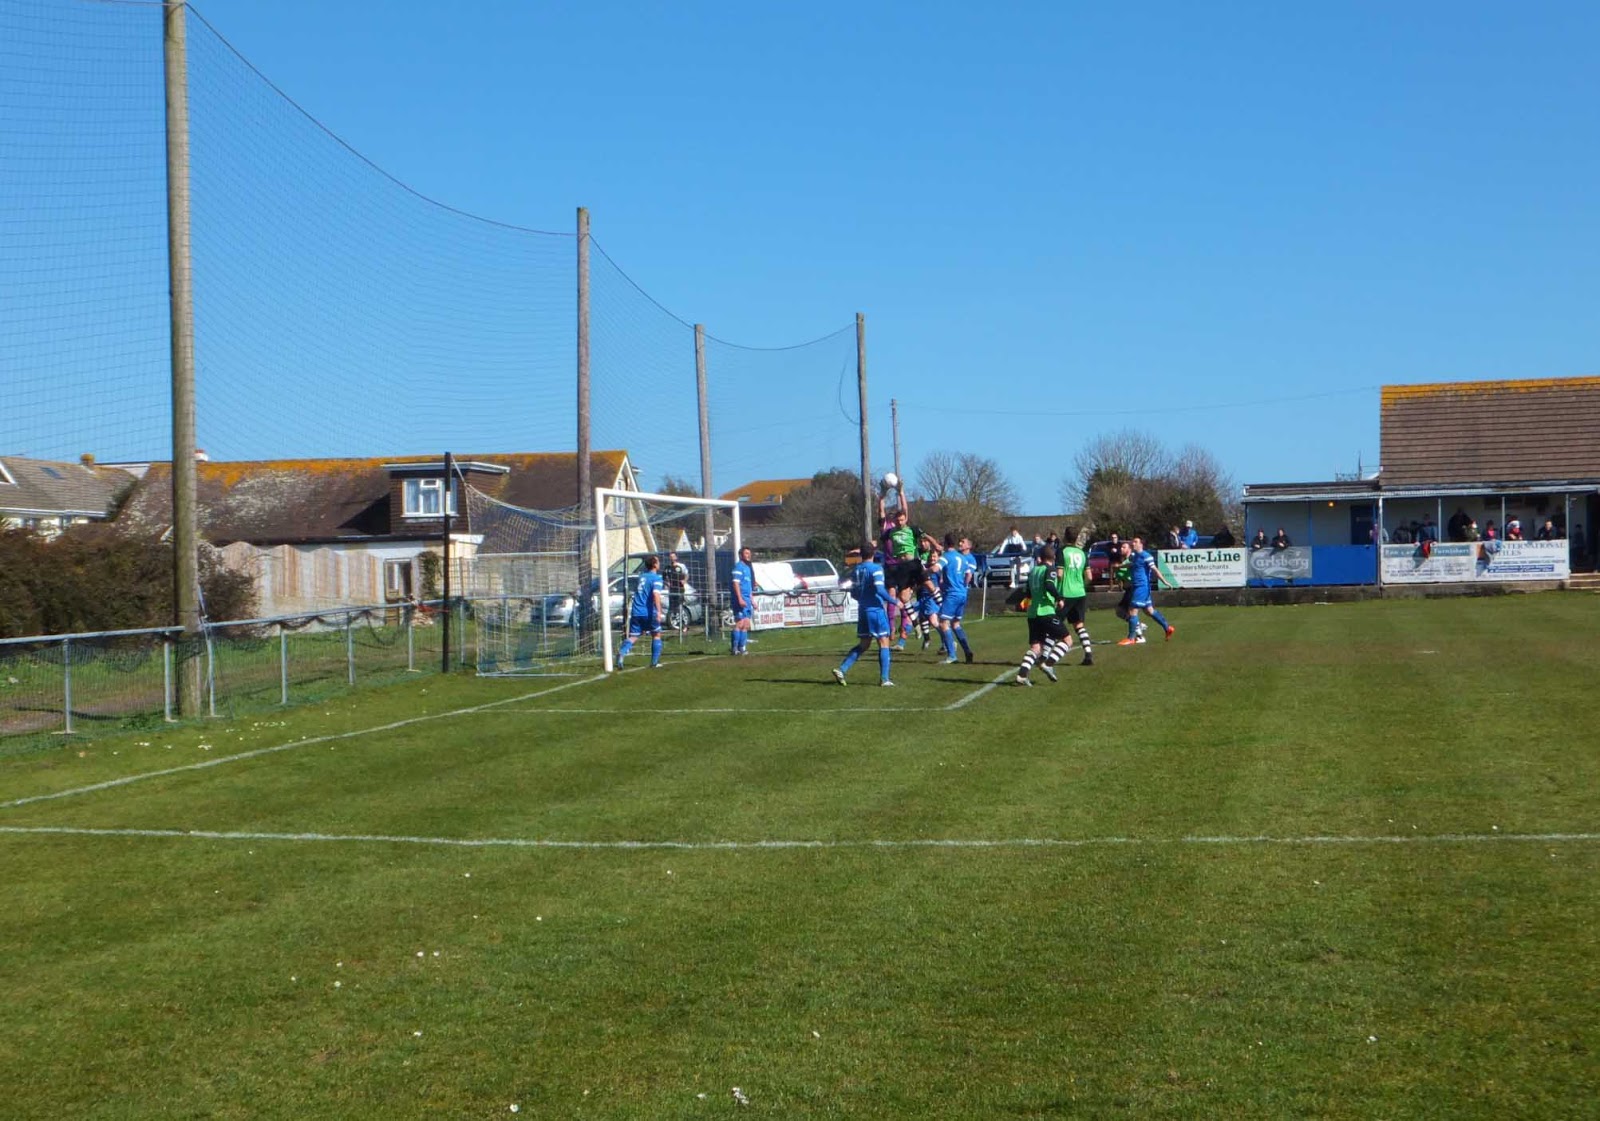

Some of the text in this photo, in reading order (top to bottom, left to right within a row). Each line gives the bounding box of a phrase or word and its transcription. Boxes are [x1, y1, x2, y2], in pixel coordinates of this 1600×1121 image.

[1068, 552, 1082, 569] 19
[1164, 551, 1241, 564] Inter-Line
[1251, 551, 1310, 571] Carlsberg
